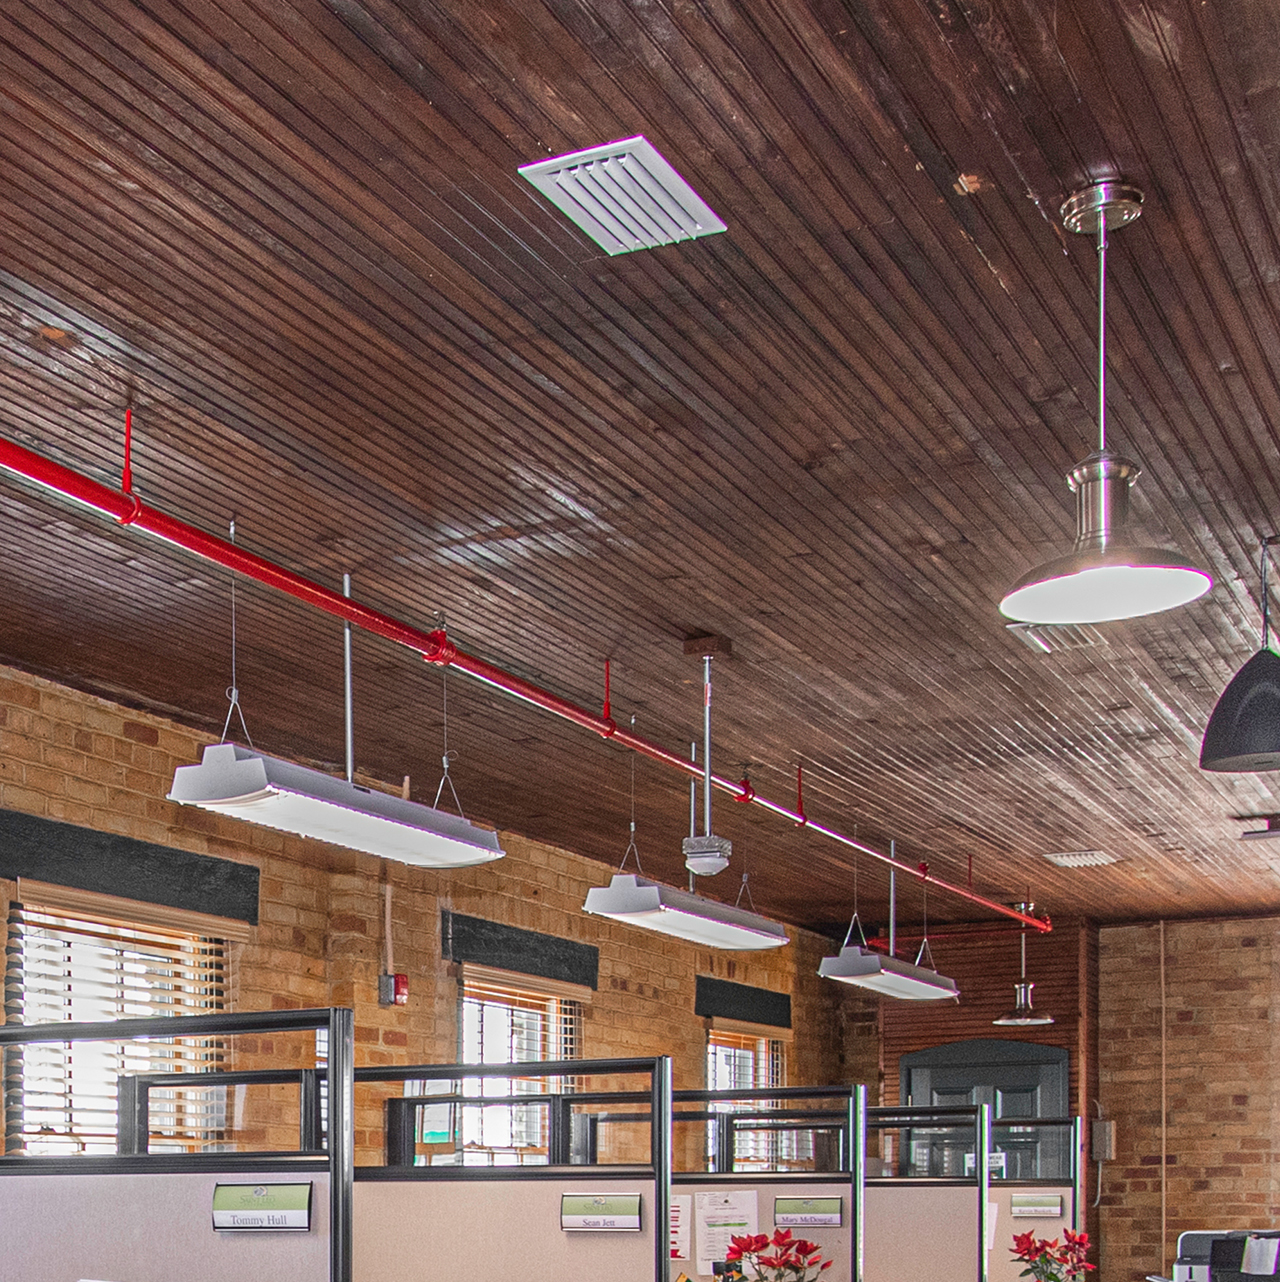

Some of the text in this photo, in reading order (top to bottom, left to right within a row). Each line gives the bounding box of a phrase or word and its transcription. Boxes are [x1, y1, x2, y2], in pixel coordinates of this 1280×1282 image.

[230, 1215, 287, 1227] Tommy Hull
[583, 1219, 616, 1227] Sean Jett
